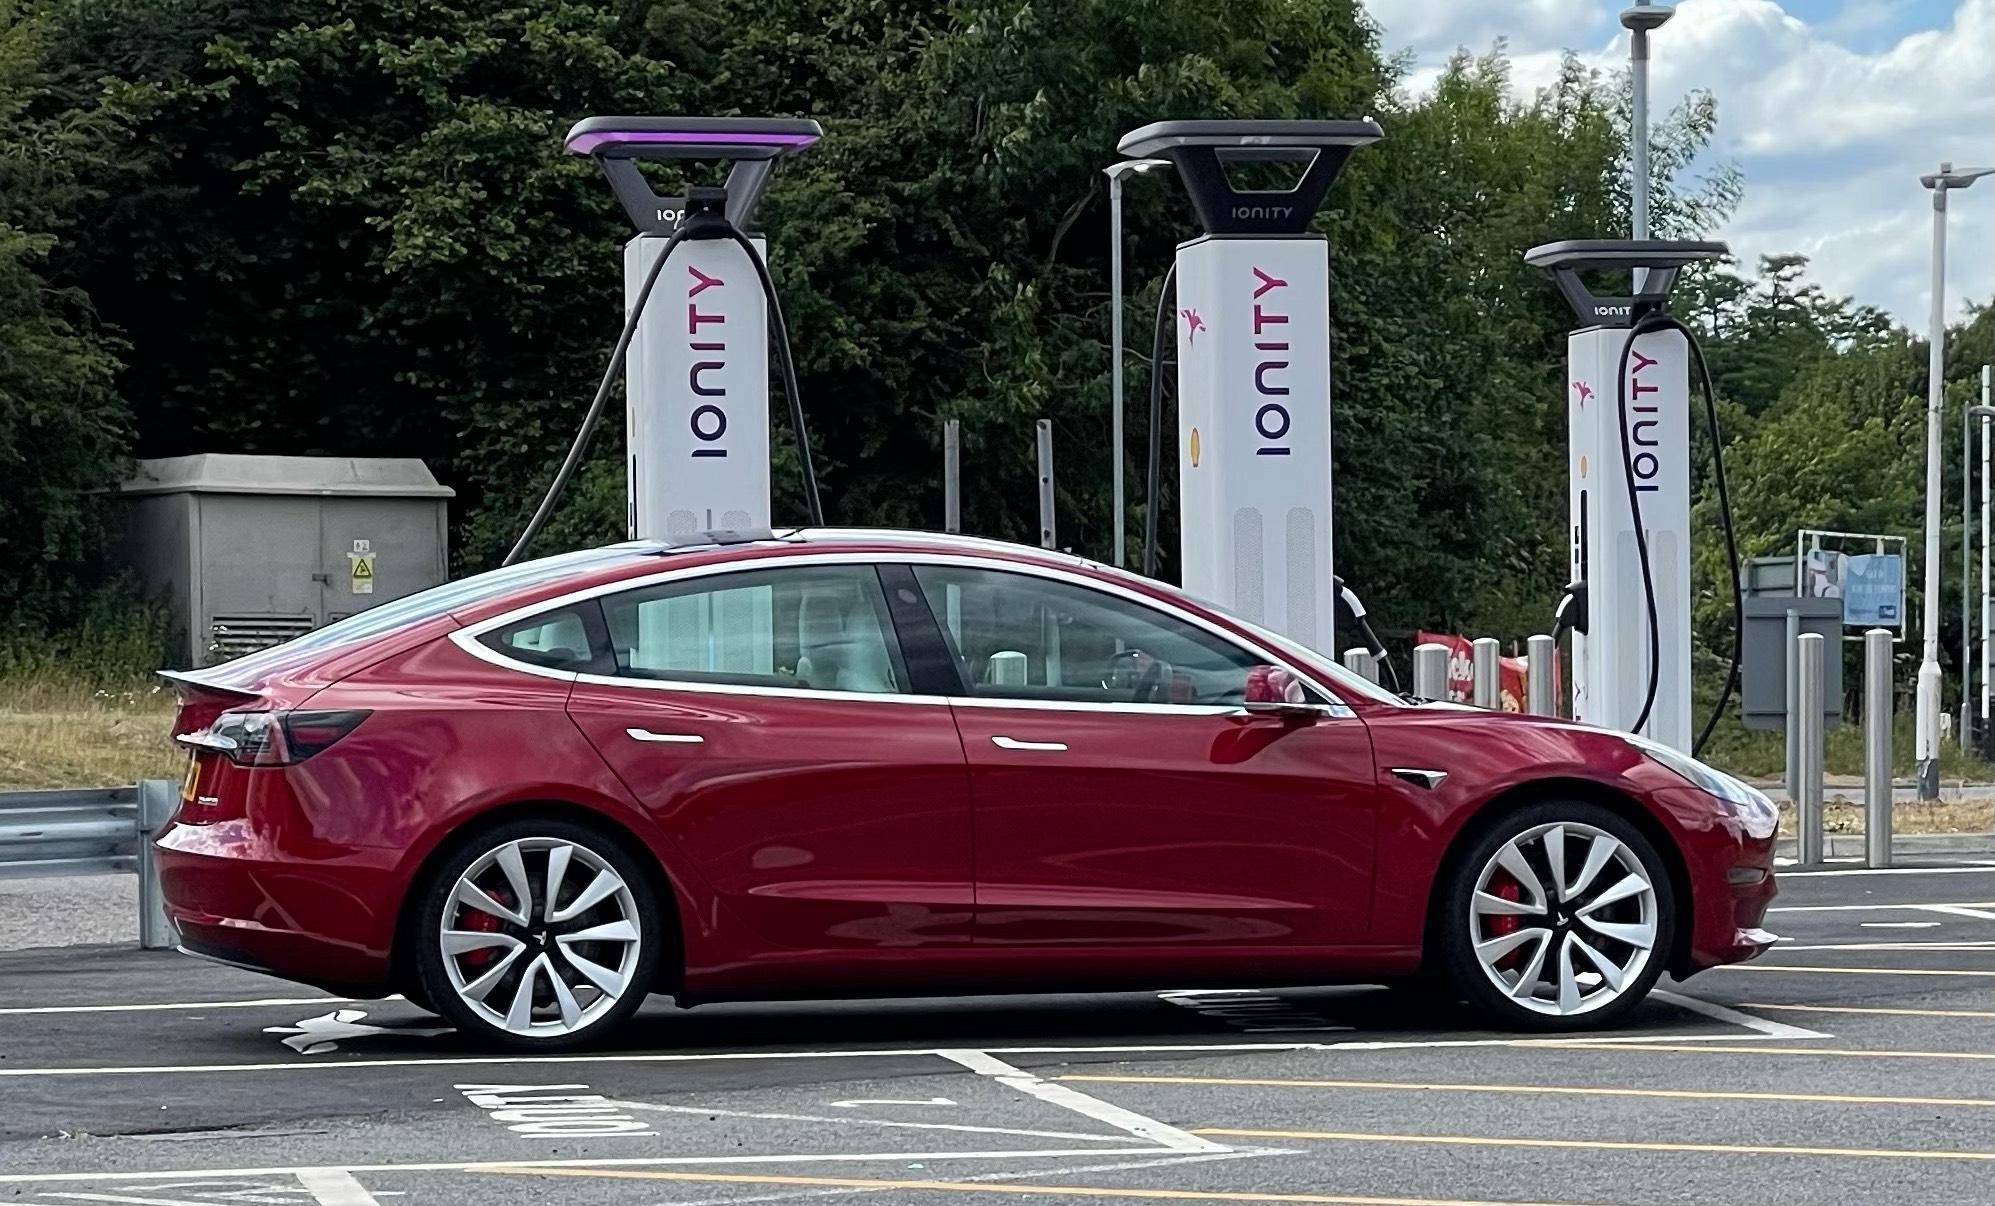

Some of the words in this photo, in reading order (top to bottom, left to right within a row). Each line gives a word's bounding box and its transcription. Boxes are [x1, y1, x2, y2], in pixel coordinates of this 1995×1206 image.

[1231, 206, 1294, 219] IONITY
[1253, 265, 1291, 456] IONITY
[1594, 306, 1631, 316] IONIT
[688, 265, 728, 458] IONITY
[1631, 350, 1659, 492] IONITY
[453, 1083, 660, 1139] IONITY
